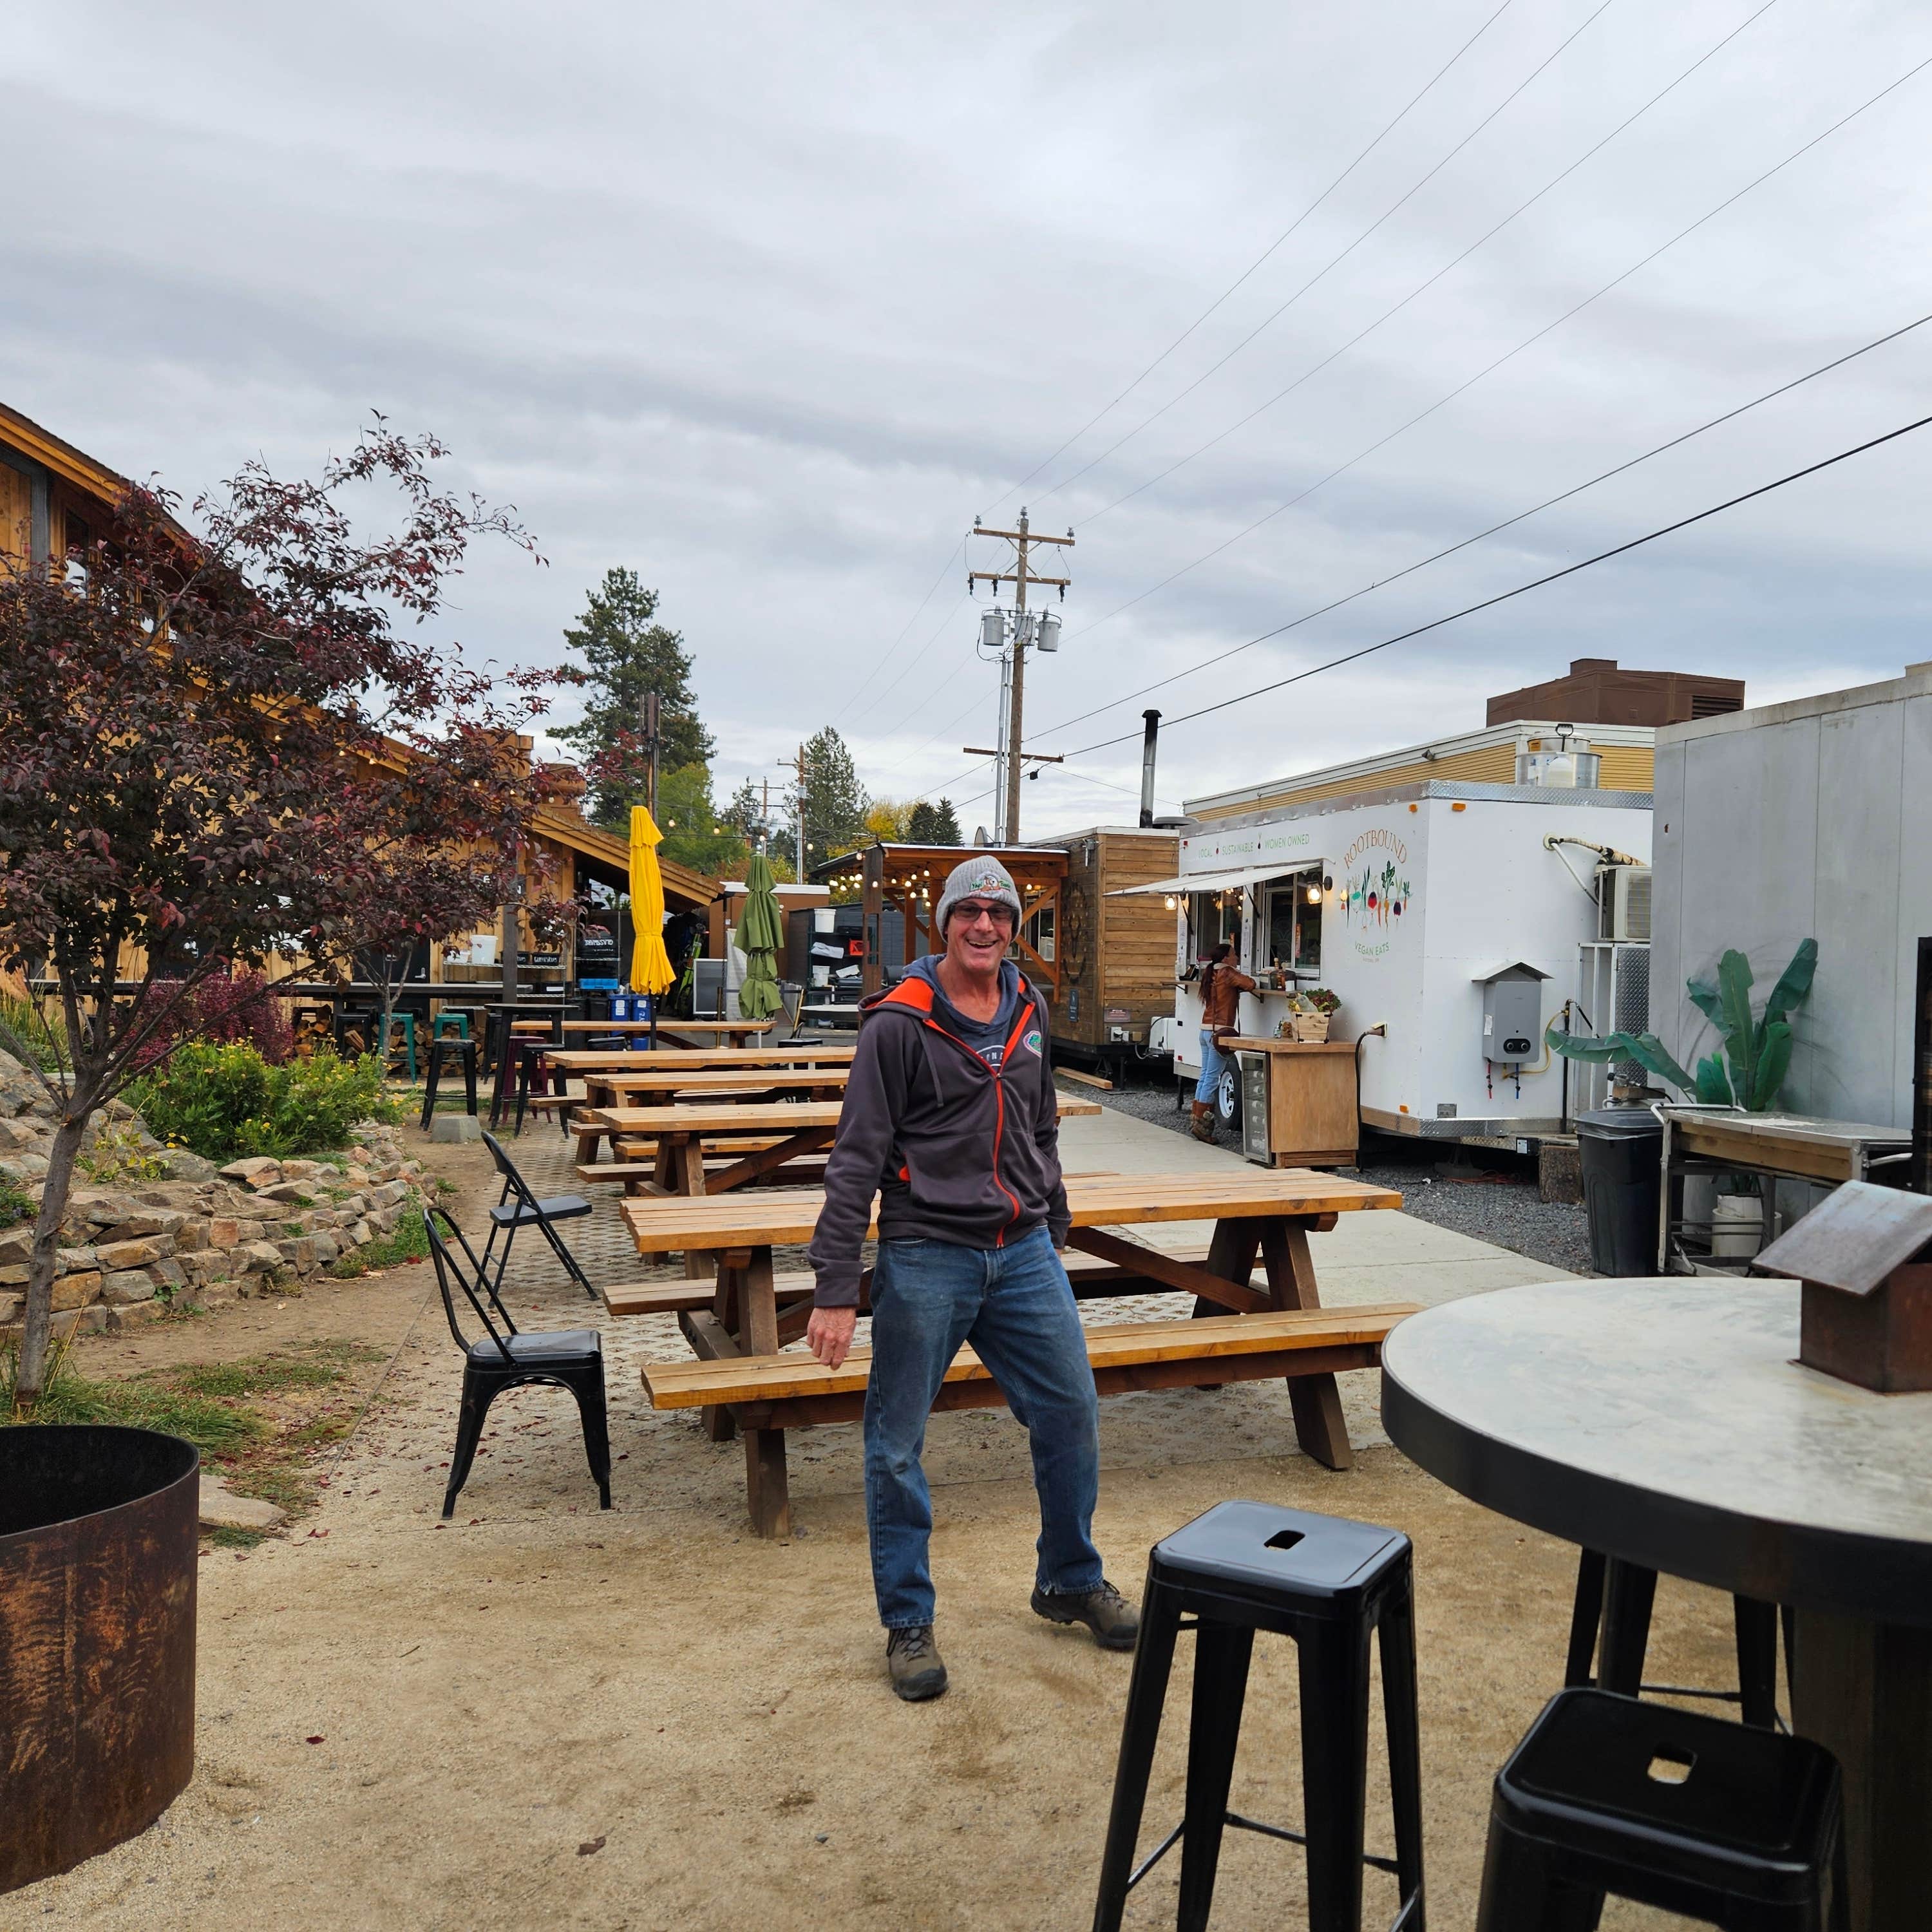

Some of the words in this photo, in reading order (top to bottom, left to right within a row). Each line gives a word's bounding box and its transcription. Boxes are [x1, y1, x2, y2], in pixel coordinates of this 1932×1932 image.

[1198, 848, 1213, 858] LOCAL
[1222, 842, 1254, 856] SUSTAINABLE
[1265, 837, 1286, 849] WOMEN
[1288, 833, 1309, 846] OWNED
[1344, 829, 1406, 869] ROOTBOUND
[1354, 940, 1374, 956] VEGAN
[1375, 941, 1390, 956] EATS
